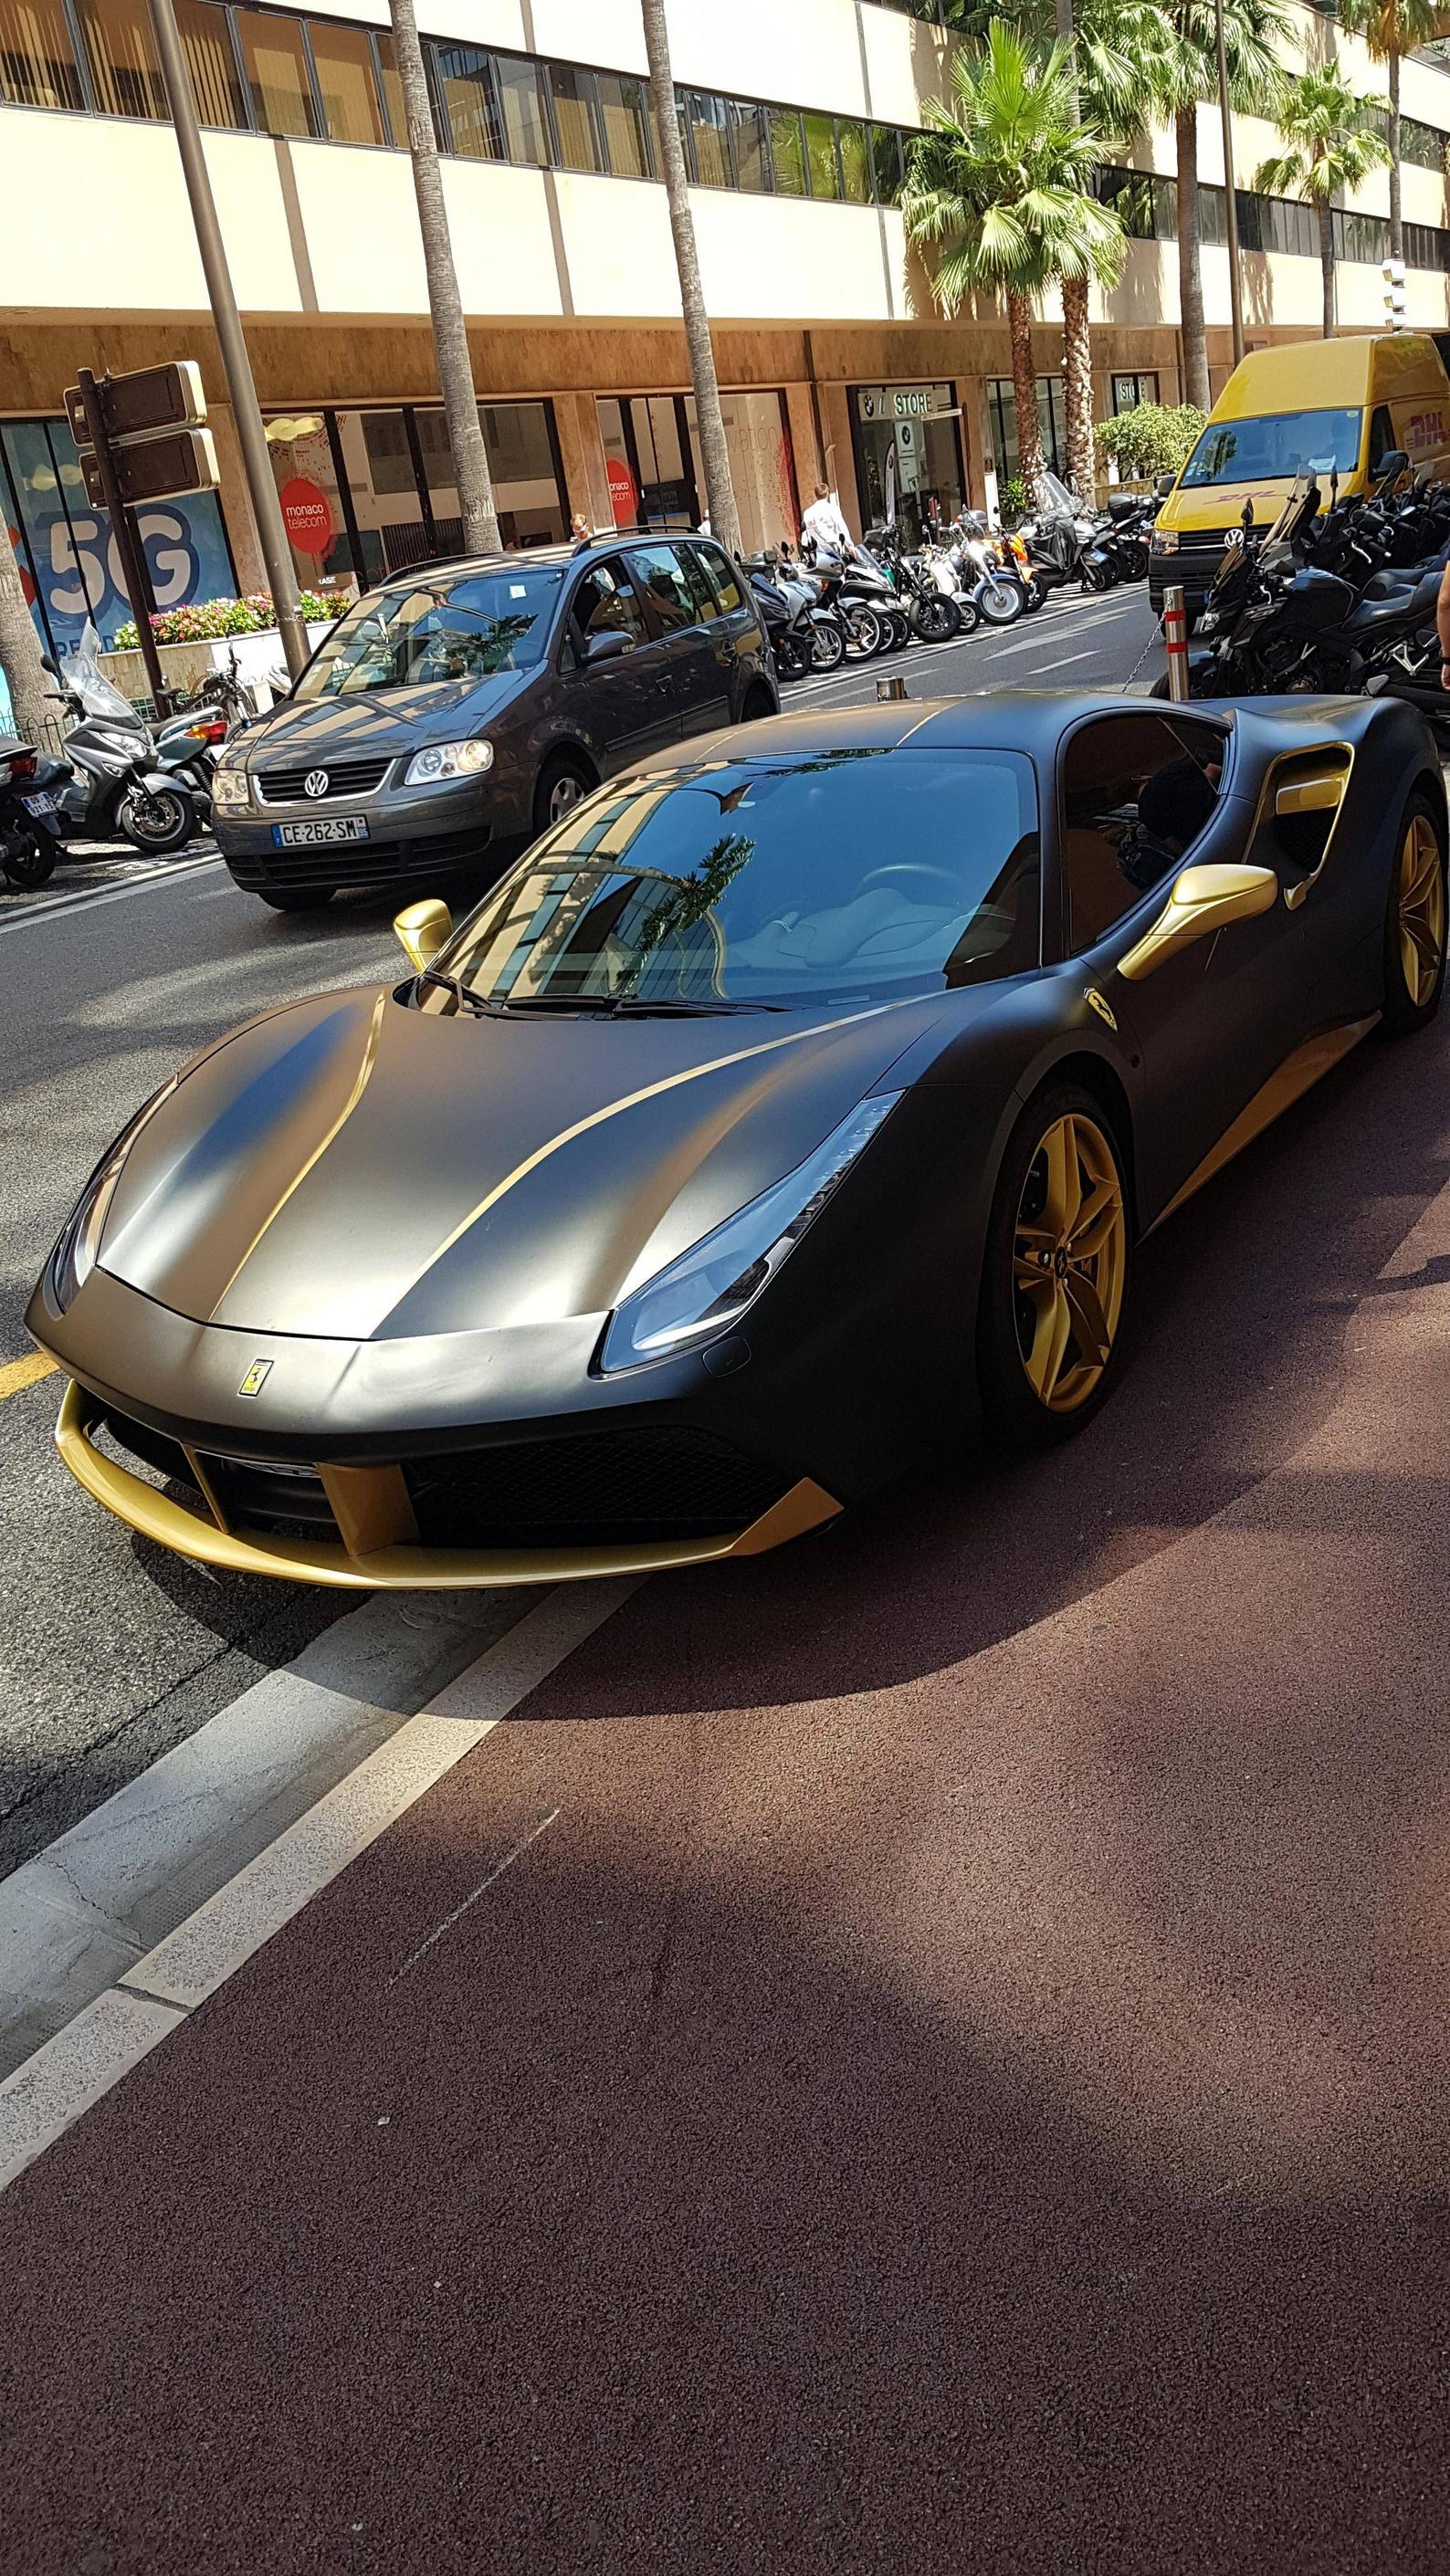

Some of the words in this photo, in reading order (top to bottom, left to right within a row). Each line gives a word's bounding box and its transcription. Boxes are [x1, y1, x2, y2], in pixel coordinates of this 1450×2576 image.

[1119, 382, 1145, 400] STOE
[894, 392, 932, 415] STORE
[608, 481, 628, 491] onaco
[286, 504, 324, 517] monaco
[289, 515, 328, 529] telecom
[49, 513, 192, 615] 5G
[283, 820, 357, 843] CE-262-SM
